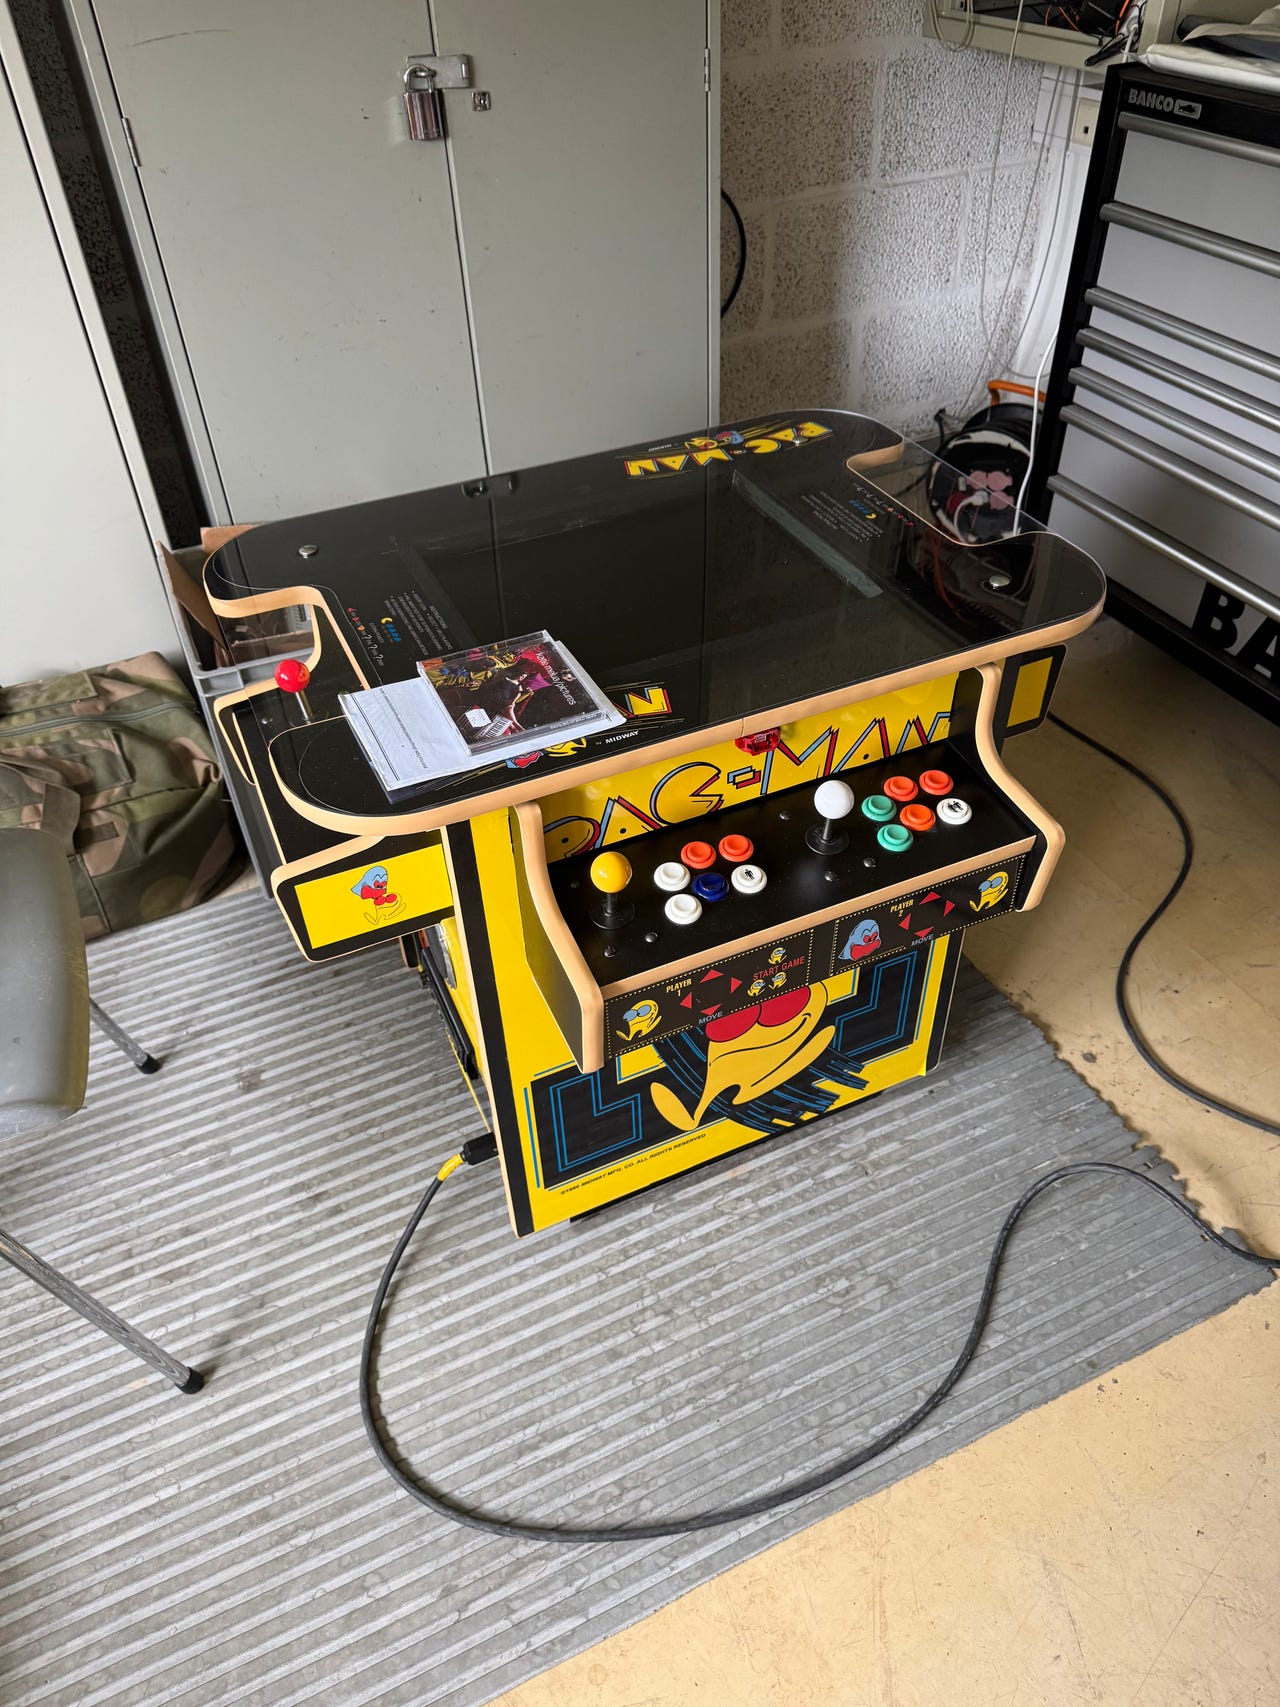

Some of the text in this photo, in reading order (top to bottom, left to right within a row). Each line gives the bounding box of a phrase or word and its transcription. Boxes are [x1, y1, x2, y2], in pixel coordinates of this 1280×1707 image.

[1128, 88, 1174, 112] BAHCO
[605, 730, 639, 744] MIDWAY
[890, 899, 914, 912] PLAYER
[911, 935, 934, 947] MOVE
[753, 956, 805, 981] START GAME
[666, 979, 692, 993] PLAYER
[698, 1010, 723, 1024] MOVE
[636, 1157, 648, 1165] ALL
[649, 1147, 672, 1159] RIGHTS
[673, 1133, 706, 1150] RESERVED
